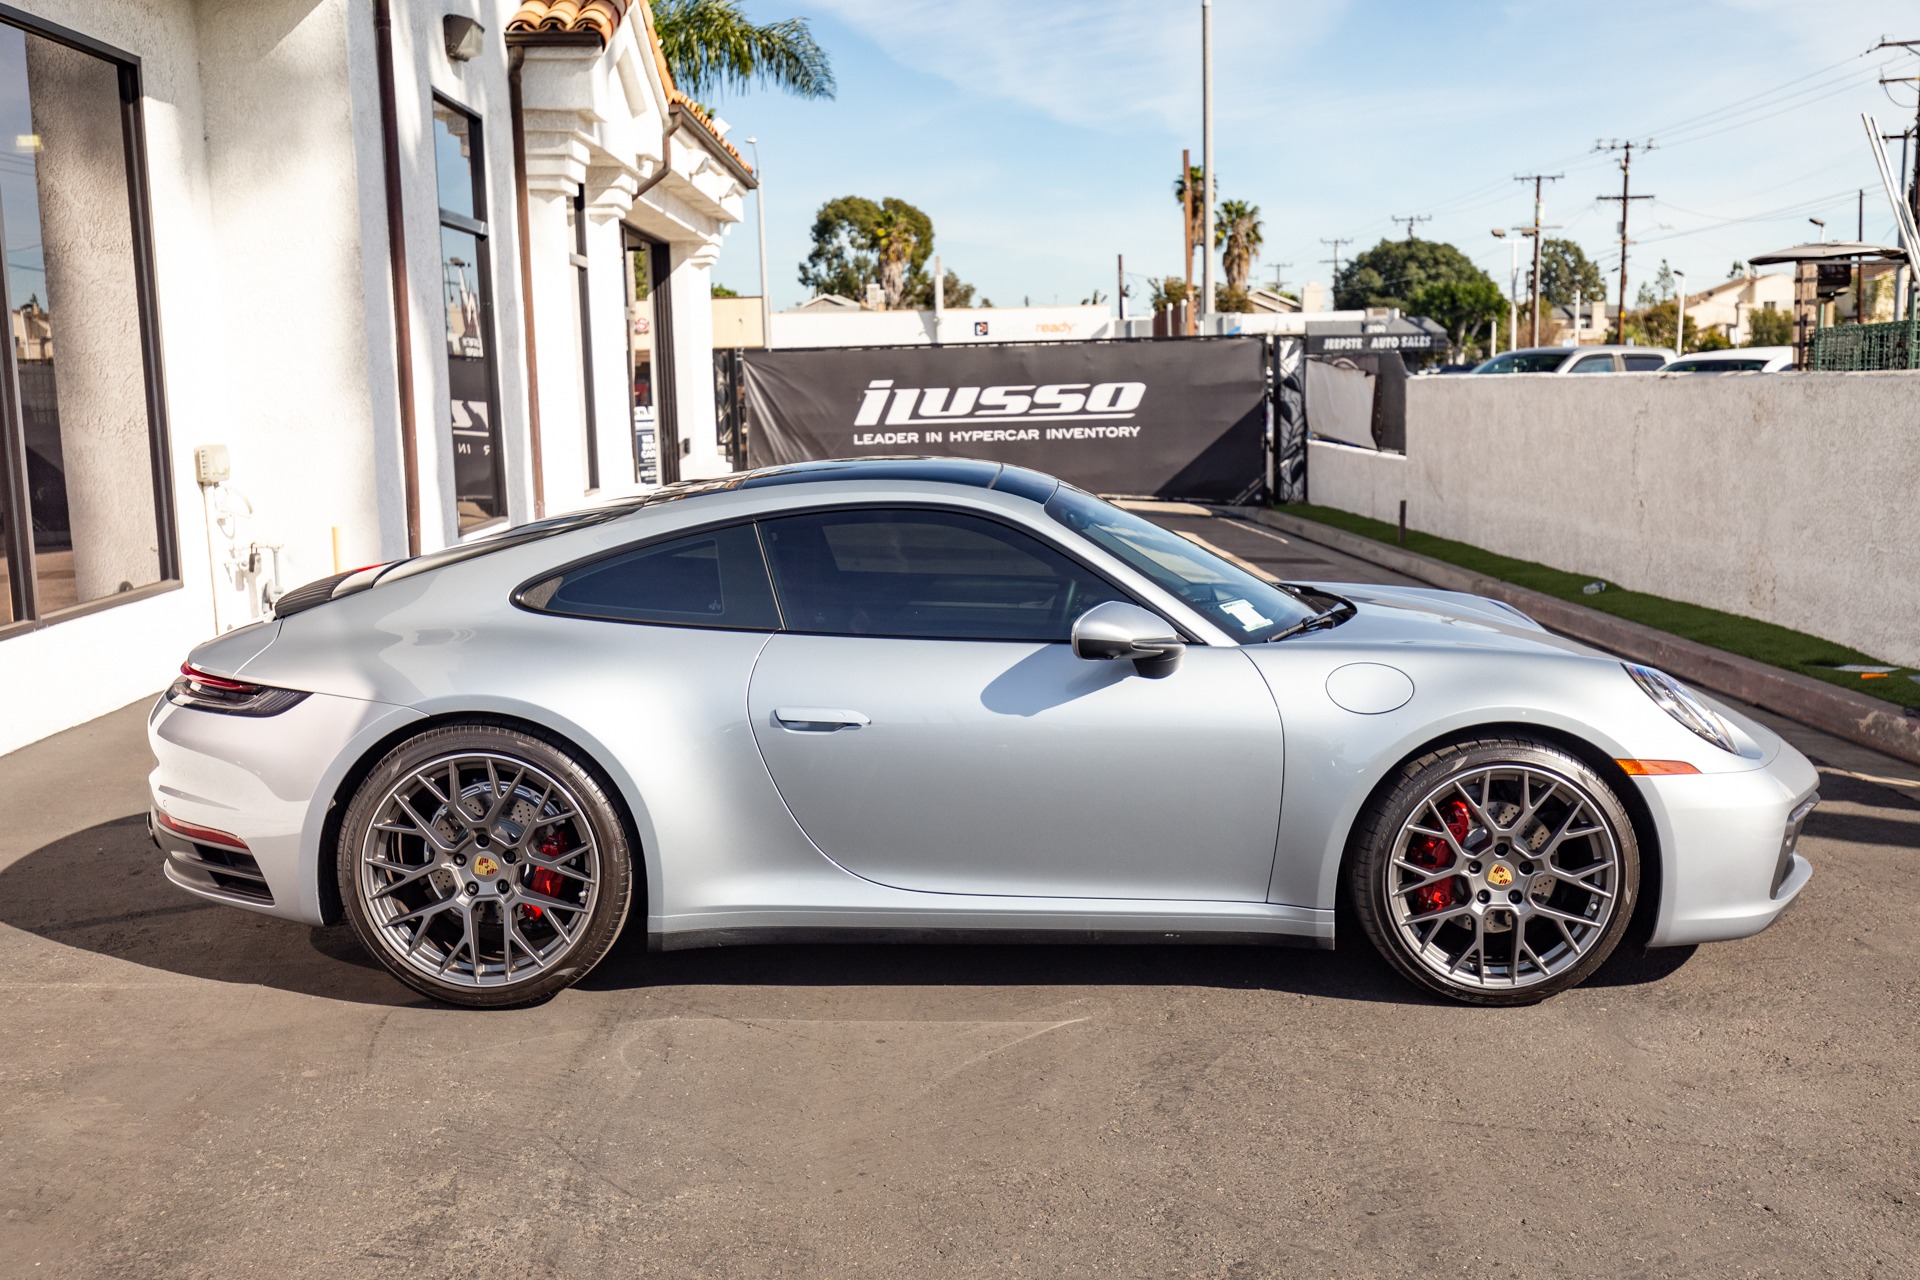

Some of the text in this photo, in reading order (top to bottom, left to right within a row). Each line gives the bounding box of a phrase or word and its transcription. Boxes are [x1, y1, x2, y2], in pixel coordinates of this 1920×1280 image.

[1370, 337, 1400, 349] AUTO
[1400, 335, 1432, 348] SALES
[853, 426, 1141, 445] LEADER IN HYPERCAR INVENTORY
